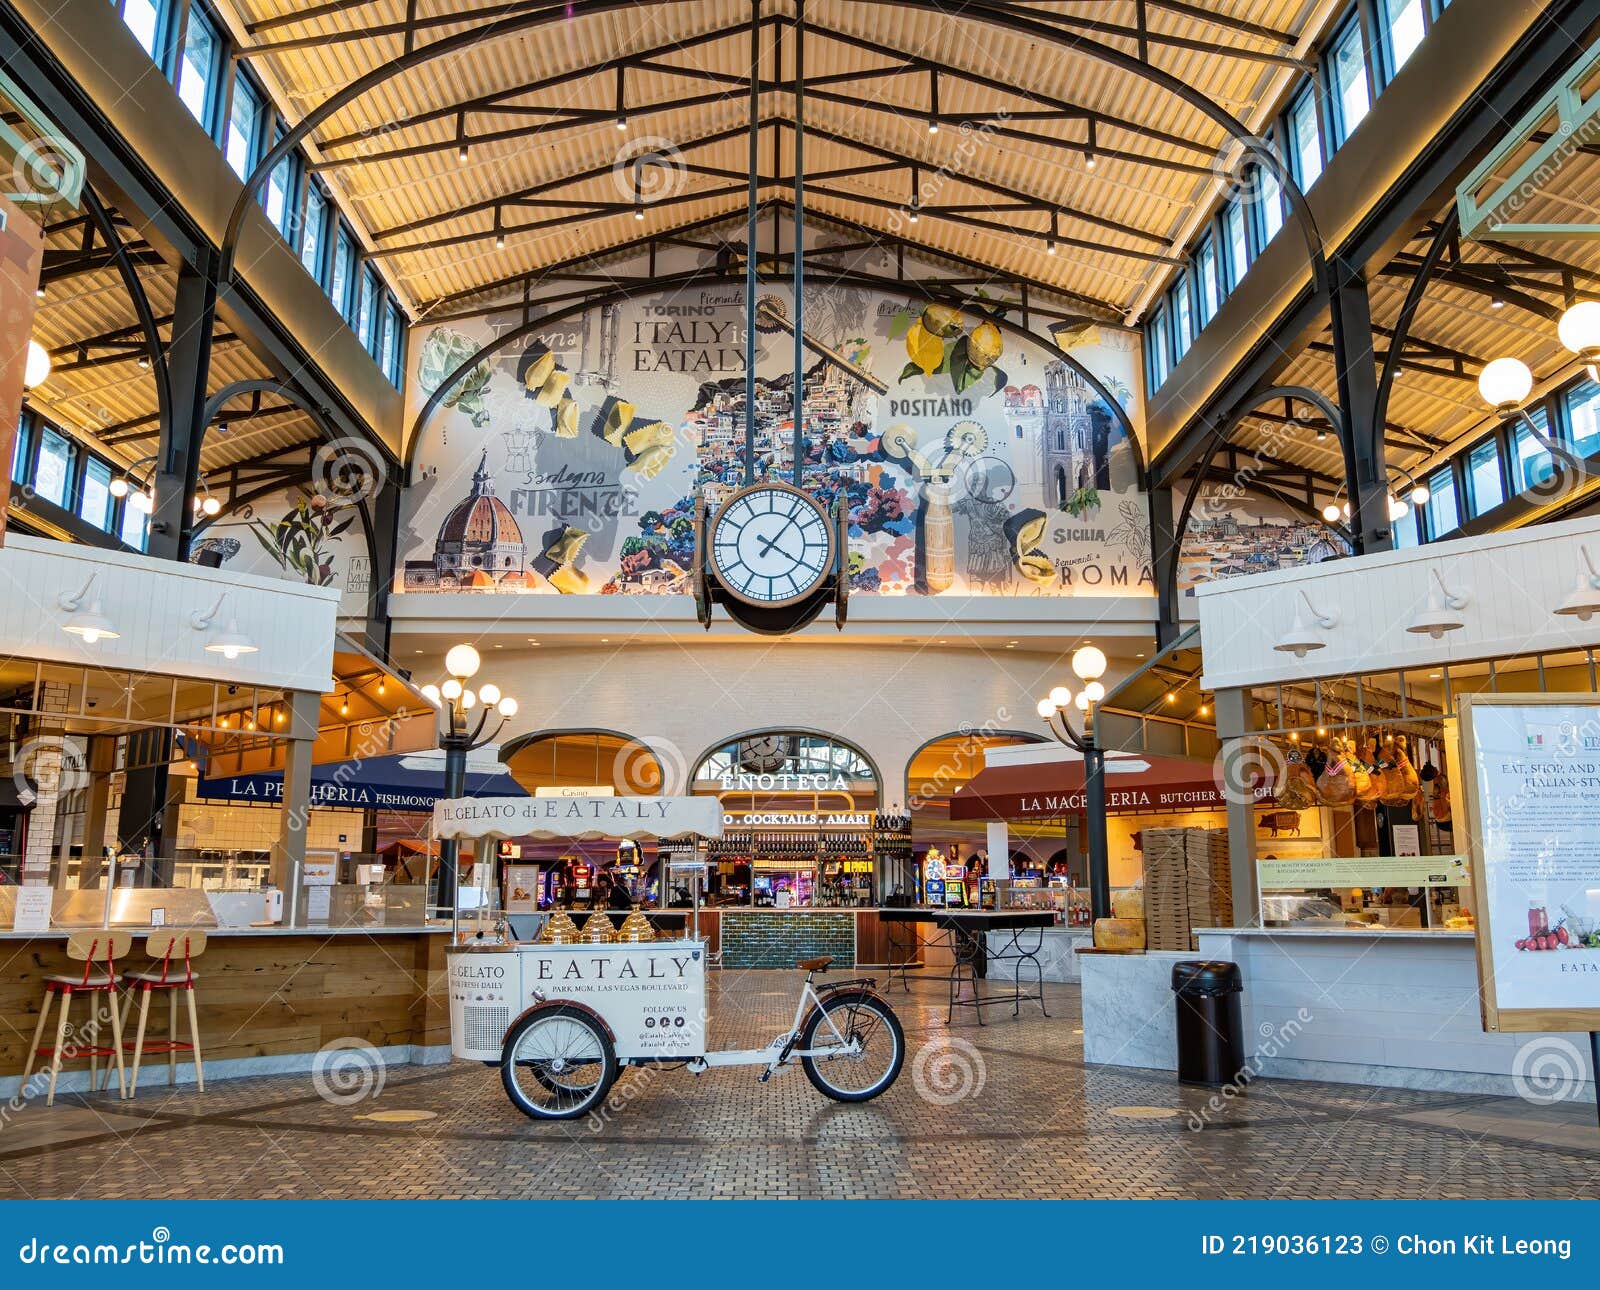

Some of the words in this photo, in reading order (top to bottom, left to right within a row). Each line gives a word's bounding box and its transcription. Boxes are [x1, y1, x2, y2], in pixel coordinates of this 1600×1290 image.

[642, 305, 715, 317] TORINO
[633, 321, 733, 344] ITALY
[633, 349, 760, 372] EATALY
[890, 398, 972, 417] POSITANO
[510, 489, 640, 520] FIRENZE
[1053, 528, 1105, 544] SICILIA
[1061, 564, 1156, 586] ROMA
[1502, 764, 1527, 775] EAT,
[1531, 763, 1565, 775] SHOP,
[1568, 763, 1596, 774] AND
[720, 774, 849, 790] ENOTECA
[230, 779, 258, 796] LA
[263, 781, 370, 803] PEHERIA
[1021, 797, 1041, 811] LA
[1045, 791, 1151, 810] MACEERIA
[1160, 790, 1217, 804] BUTCHER
[444, 808, 454, 821] IL
[455, 804, 516, 821] GELATO
[522, 805, 537, 818] di
[544, 800, 672, 818] EATALY
[743, 814, 817, 825] COCKTAILS
[826, 814, 869, 825] AMARI
[457, 966, 505, 979] GELATO
[537, 957, 691, 980] EATALY
[481, 981, 504, 989] DAILY
[552, 985, 572, 993] PARK
[598, 984, 613, 992] LAS
[614, 984, 640, 992] VEGAS
[641, 983, 689, 992] BOULEVARD
[643, 1005, 675, 1014] FOLLOW
[677, 1005, 687, 1013] US
